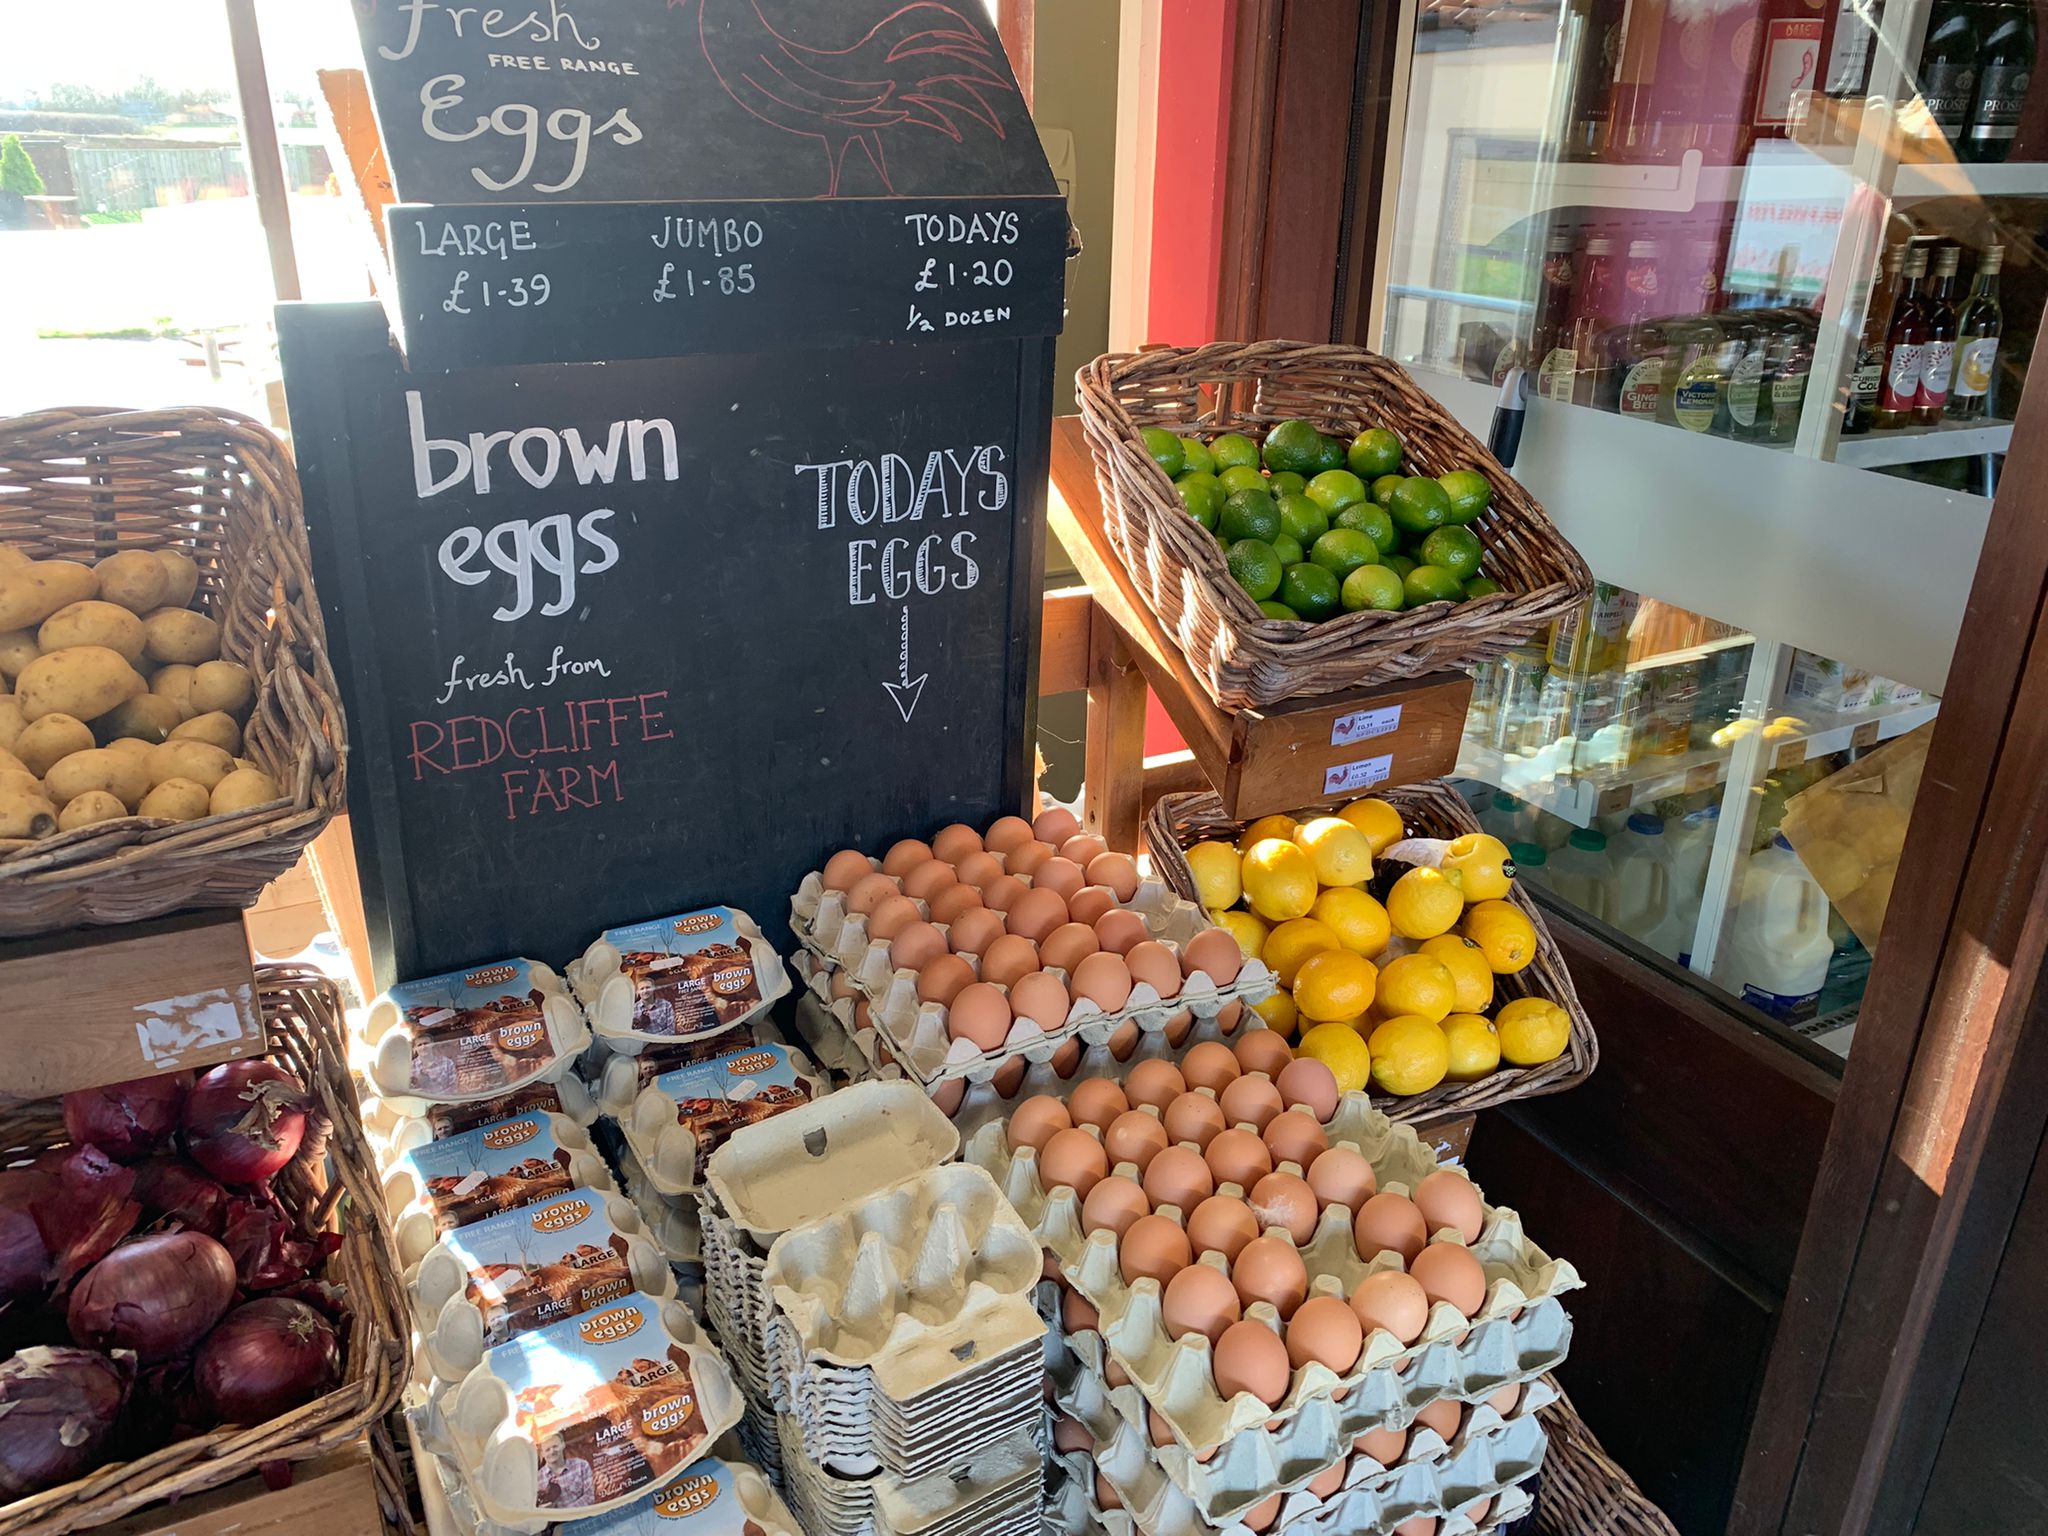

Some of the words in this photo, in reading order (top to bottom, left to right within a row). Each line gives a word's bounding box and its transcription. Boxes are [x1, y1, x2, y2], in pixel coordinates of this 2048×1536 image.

[488, 53, 550, 71] FREE
[560, 57, 640, 76] RANGE
[419, 74, 643, 193] Eggs
[651, 216, 763, 257] JUMBO
[905, 210, 1019, 246] TODAYS
[415, 220, 537, 260] LARGE
[945, 306, 1011, 327] DOZEN
[1857, 382, 1879, 391] COL
[406, 390, 680, 498] brown
[795, 445, 1009, 530] TODAYS
[437, 508, 620, 622] eggs
[848, 531, 980, 606] EGGS
[436, 654, 535, 704] fresh
[542, 645, 612, 686] from
[407, 690, 674, 781] REDCLIFFE
[1352, 762, 1372, 771] Lemon
[502, 759, 625, 820] FARM
[673, 912, 719, 928] brown
[683, 920, 716, 933] eggs
[465, 964, 515, 981] brown
[475, 972, 510, 986] eggs
[713, 967, 751, 983] brown
[677, 977, 706, 990] LARGE
[719, 979, 746, 991] eggs
[459, 1033, 492, 1046] LARGE
[499, 1021, 542, 1038] brown
[506, 1033, 537, 1048] eggs
[726, 1051, 772, 1068] brown
[736, 1060, 770, 1074] eggs
[515, 1097, 556, 1115] brown
[478, 1111, 509, 1127] LARGE
[483, 1119, 535, 1140] brown
[494, 1130, 531, 1146] eggs
[519, 1161, 561, 1179] LARGE
[531, 1199, 587, 1222] brown
[543, 1211, 584, 1229] eggs
[573, 1249, 616, 1269] LARGE
[581, 1277, 628, 1300] brown
[537, 1296, 573, 1316] LARGE
[579, 1305, 639, 1332] brown
[593, 1319, 637, 1340] eggs
[630, 1362, 677, 1387] LARGE
[642, 1394, 691, 1423] brown
[595, 1418, 633, 1442] LARGE
[651, 1411, 685, 1431] eggs
[653, 1474, 713, 1505] brown
[667, 1487, 712, 1513] eggs
